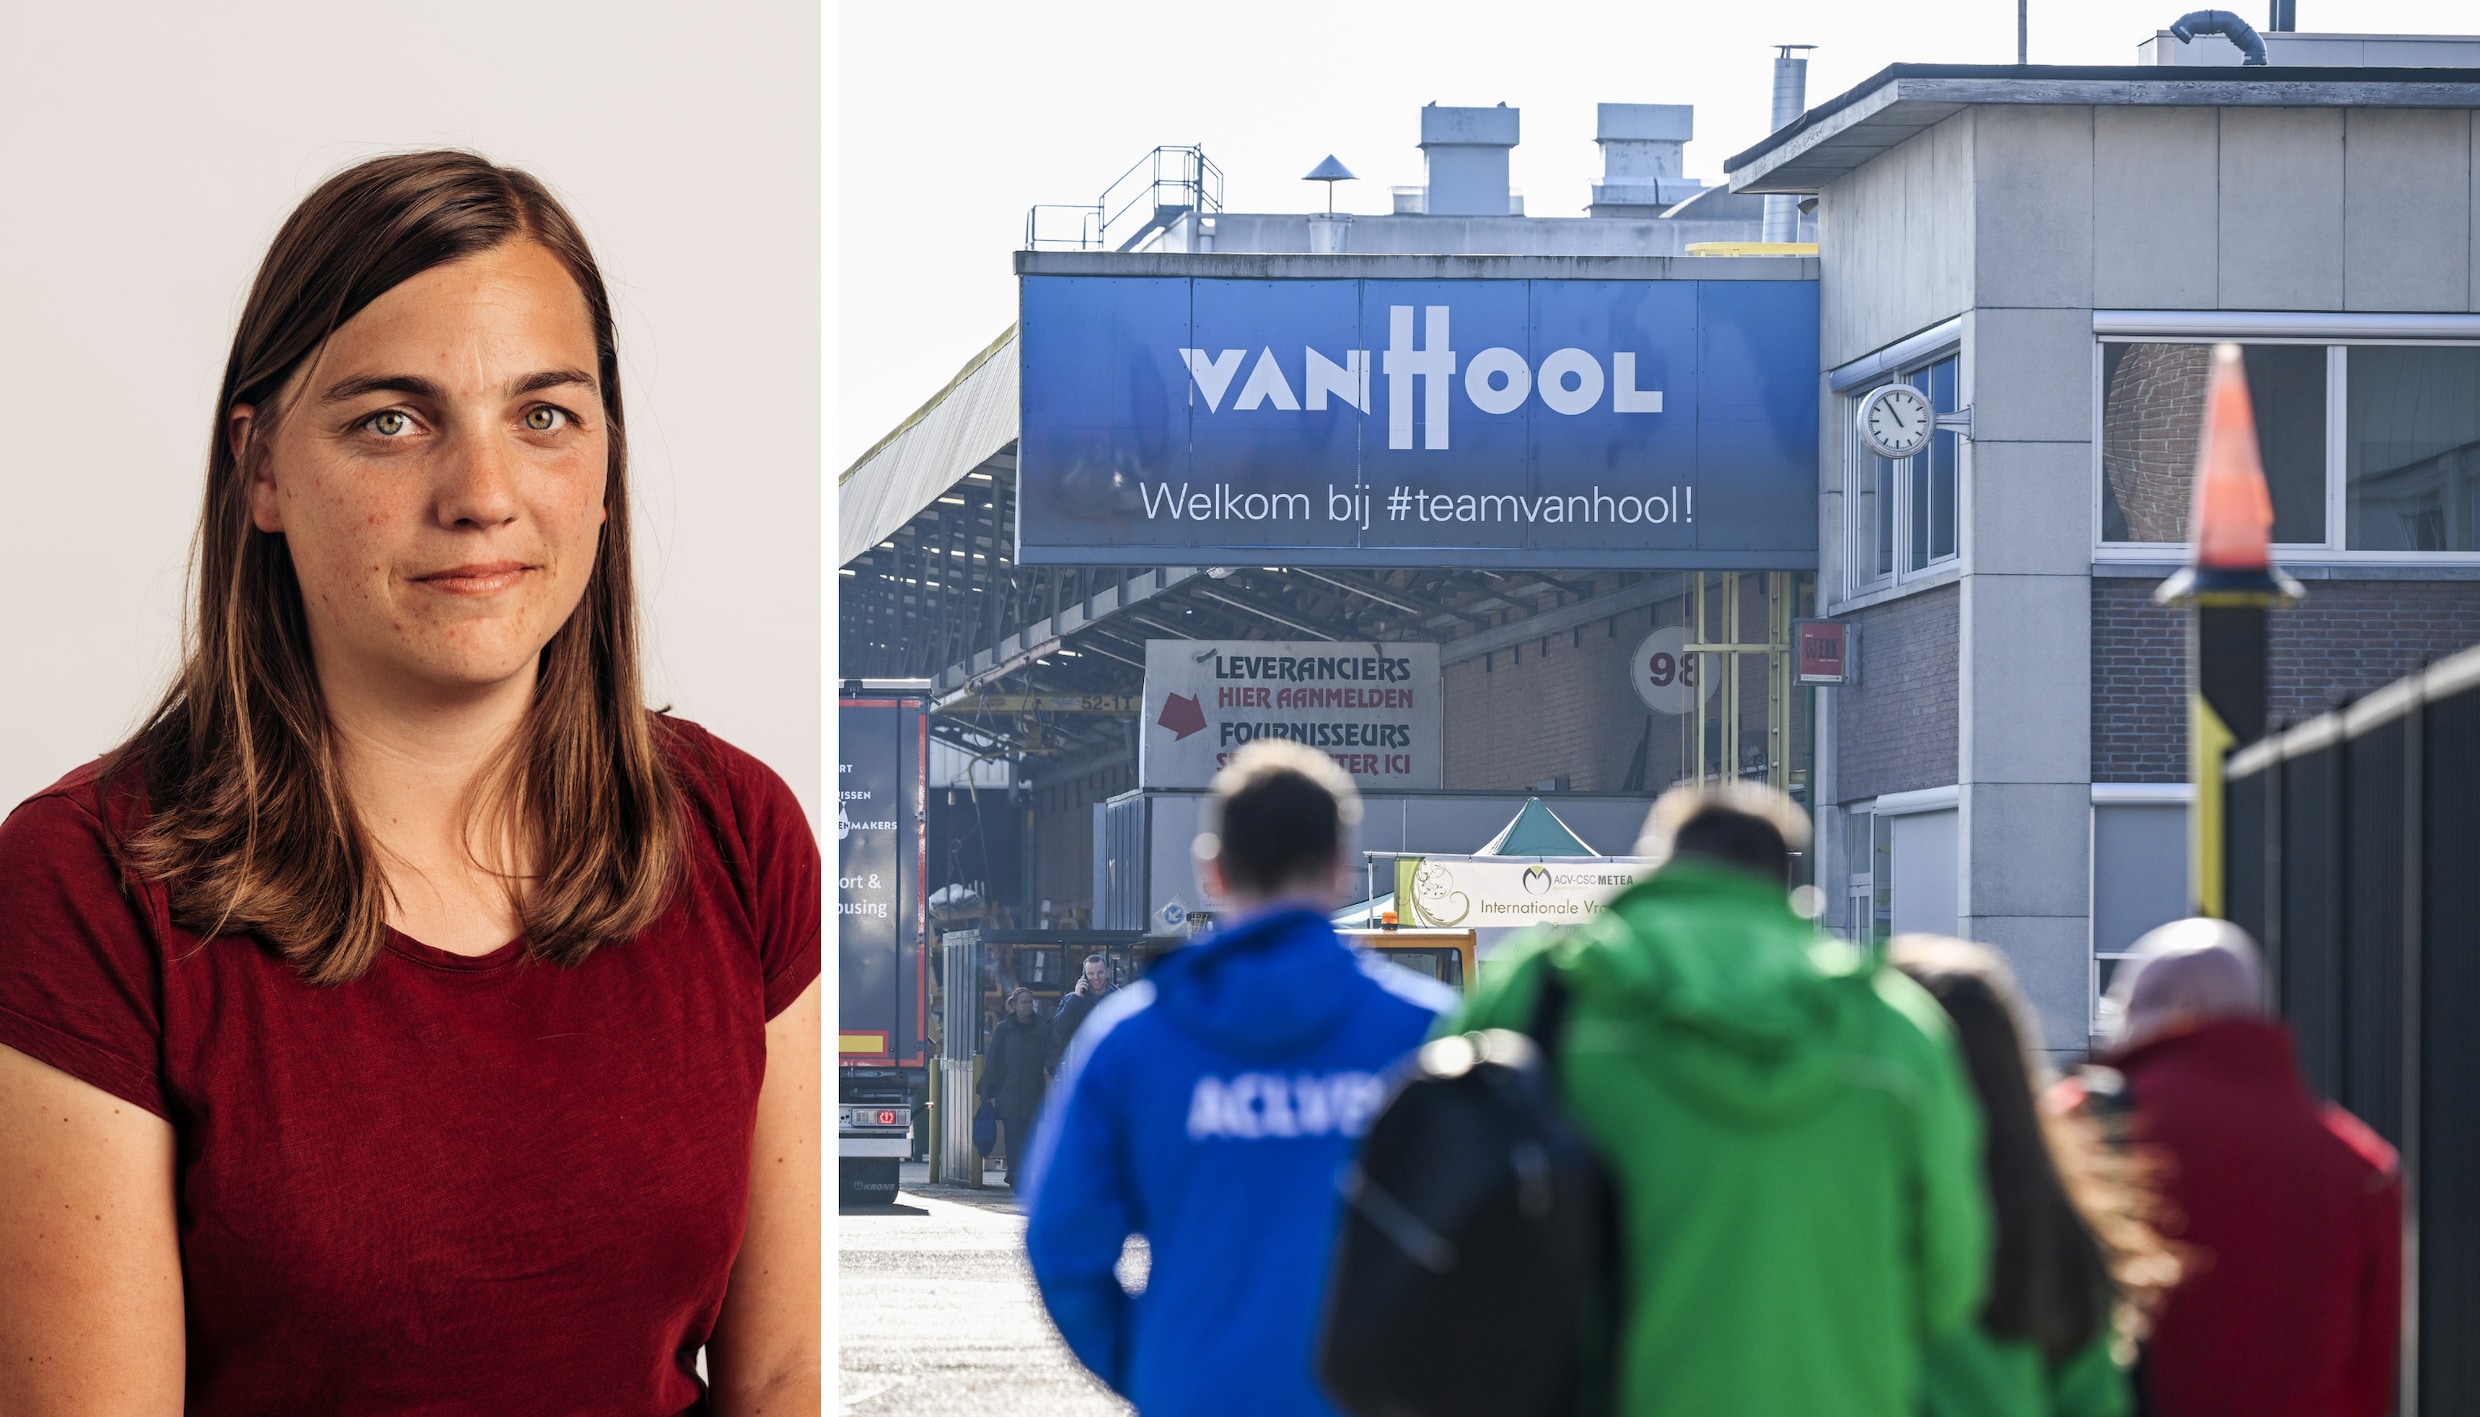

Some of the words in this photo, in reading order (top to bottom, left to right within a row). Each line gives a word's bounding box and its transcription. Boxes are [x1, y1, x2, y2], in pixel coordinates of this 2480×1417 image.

[1139, 482, 1310, 523] Welkom
[1328, 484, 1371, 530] bij
[1387, 484, 1693, 523] #teamvanhool!
[1215, 656, 1411, 683] LEVERANCIERS
[1649, 652, 1699, 687] 98
[1219, 687, 1272, 709] HIER
[1277, 687, 1414, 710] AANMELDEN
[1220, 722, 1411, 749] FOURNISSEURS
[1385, 754, 1410, 775] ICI
[839, 791, 871, 800] ISSEN
[839, 875, 863, 889] ort
[868, 874, 882, 889] &
[1481, 899, 1579, 914] Internationale
